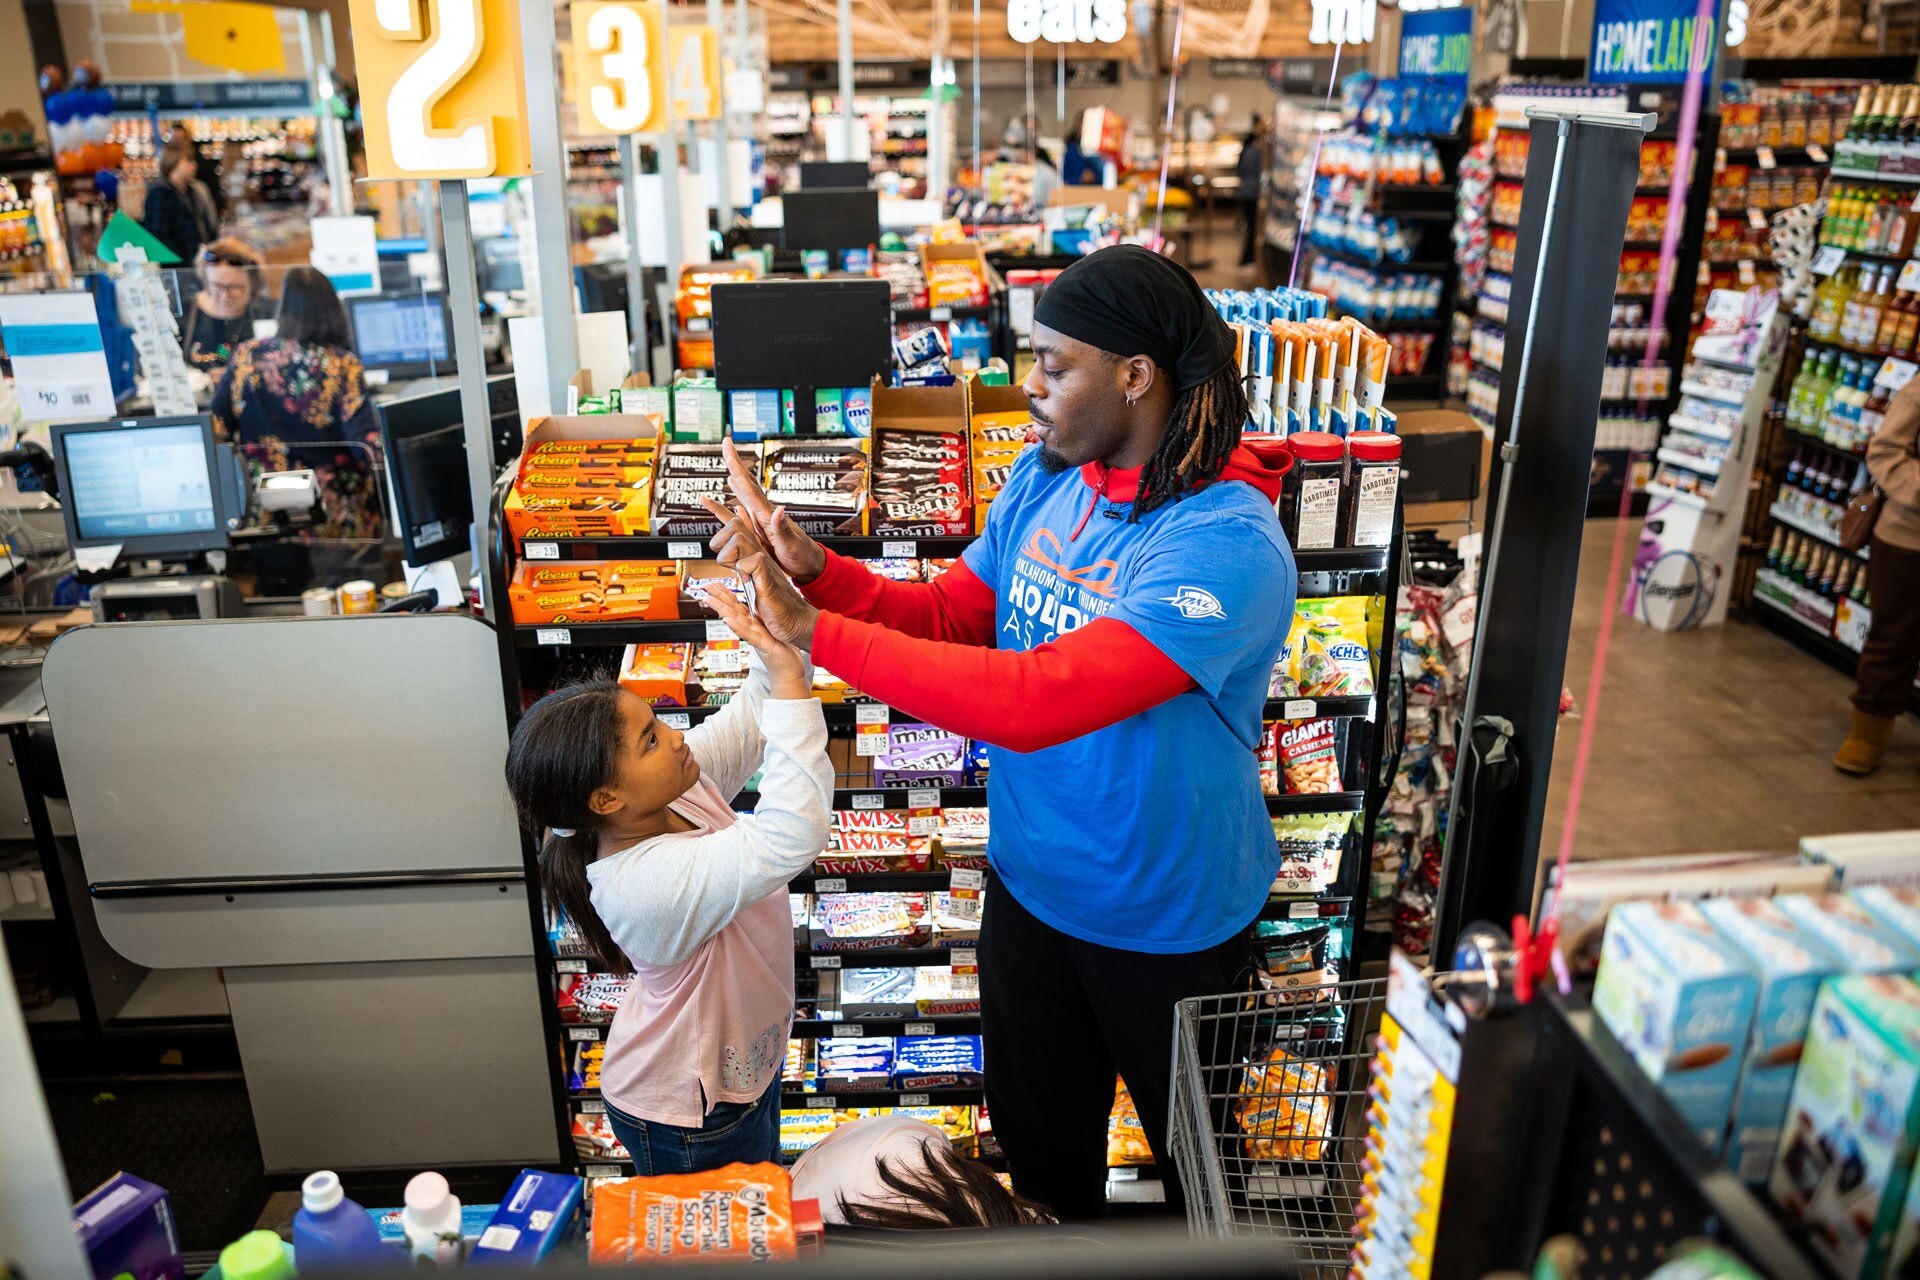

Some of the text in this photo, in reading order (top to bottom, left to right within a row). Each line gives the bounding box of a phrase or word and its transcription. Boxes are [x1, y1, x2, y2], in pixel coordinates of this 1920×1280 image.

[1595, 17, 1715, 74] HOMELAND
[587, 6, 652, 131] 3
[674, 33, 712, 115] 4
[387, 0, 489, 171] 2
[535, 441, 590, 453] Reese's
[527, 454, 582, 465] Reese's
[523, 473, 579, 483] Reese's
[666, 477, 725, 491] HERSHEY'S
[776, 473, 837, 490] HERSHEY'S
[1362, 476, 1397, 493] HARDTIMES
[1303, 488, 1338, 505] HARDTIMES
[525, 528, 576, 538] Reese's
[795, 521, 834, 533] SHEY'S
[544, 546, 557, 556] 2.39
[687, 546, 700, 556] 2.39
[901, 545, 914, 554] 2.39
[534, 568, 579, 580] Reese's
[613, 563, 657, 574] Reese's
[1015, 557, 1056, 589] OKLAHOM
[535, 595, 579, 606] Reese's
[556, 632, 569, 641] 1.29
[707, 692, 731, 706] Milk
[1280, 719, 1335, 749] GIANTS
[1288, 736, 1335, 757] CASHEWS
[1309, 748, 1333, 759] PICKLE
[928, 1001, 981, 1016] PAYDAY
[580, 1012, 616, 1020] Moun
[905, 1076, 956, 1089] CRUNCH
[646, 1205, 660, 1248] Flavor
[661, 1196, 676, 1254] Chicken
[680, 1201, 700, 1247] Soup
[701, 1190, 717, 1251] Noodle
[718, 1191, 734, 1249] Ramen
[749, 1200, 772, 1264] Maruch
